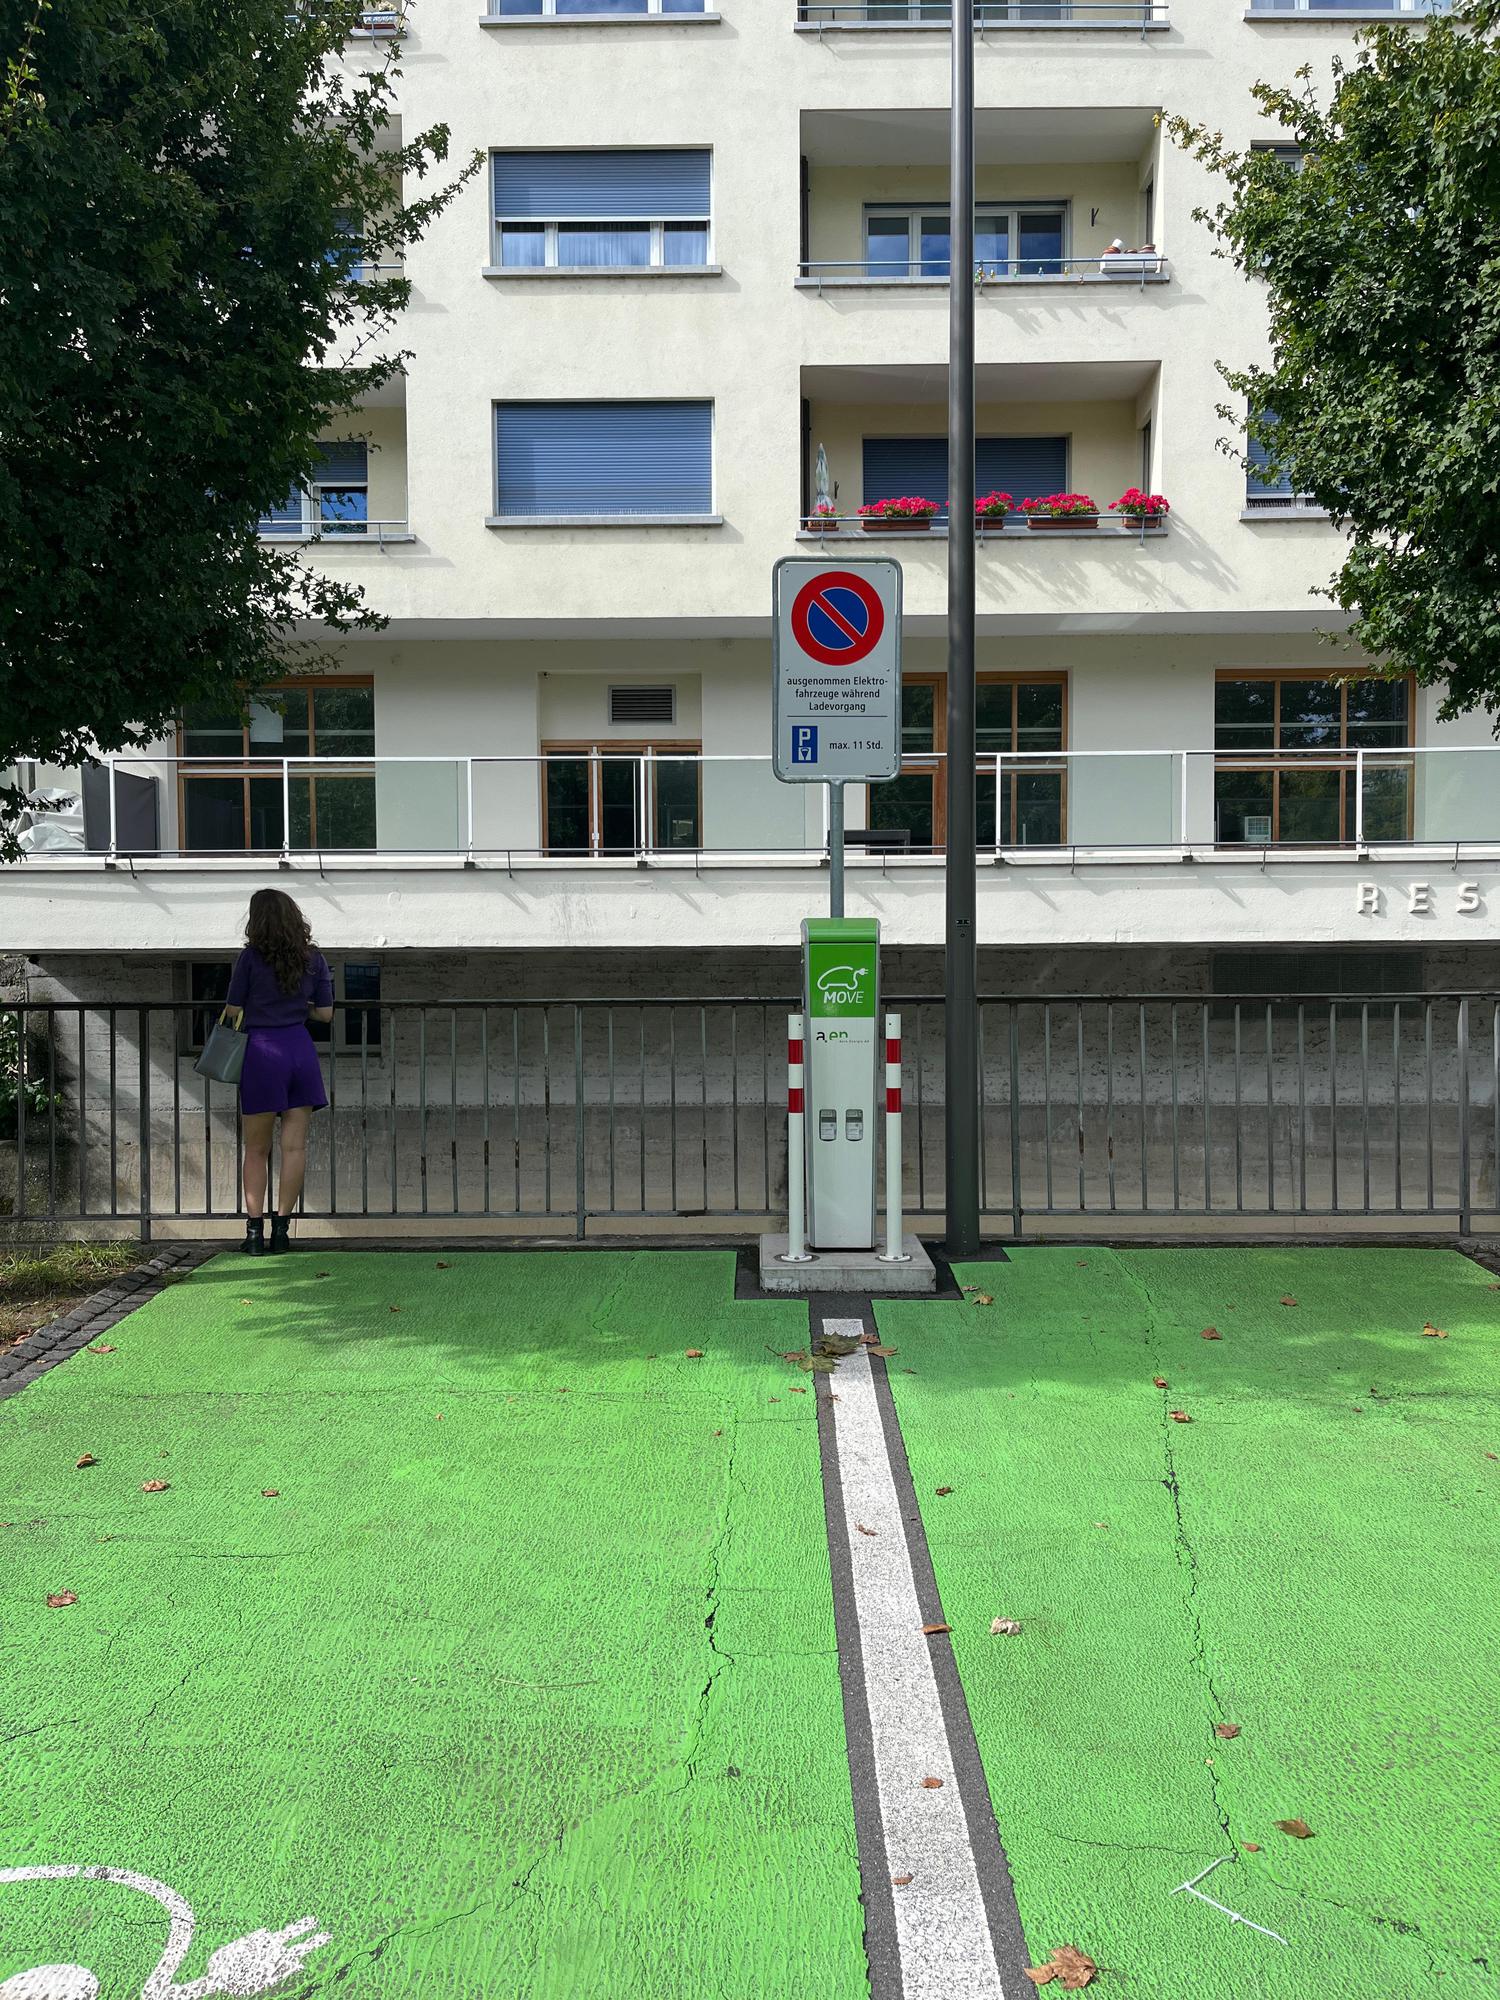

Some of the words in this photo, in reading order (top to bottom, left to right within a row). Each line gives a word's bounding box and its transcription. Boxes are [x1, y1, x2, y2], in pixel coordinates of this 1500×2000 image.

[787, 677, 851, 687] ausgenommen
[853, 676, 888, 686] Elektro-
[795, 689, 839, 700] fahrzeuge
[841, 689, 880, 699] während
[809, 702, 866, 712] Ladevorgang
[799, 728, 811, 747] P
[829, 742, 850, 750] max.
[853, 741, 863, 749] 11
[866, 740, 884, 750] Std.
[823, 991, 865, 1004] MOVE
